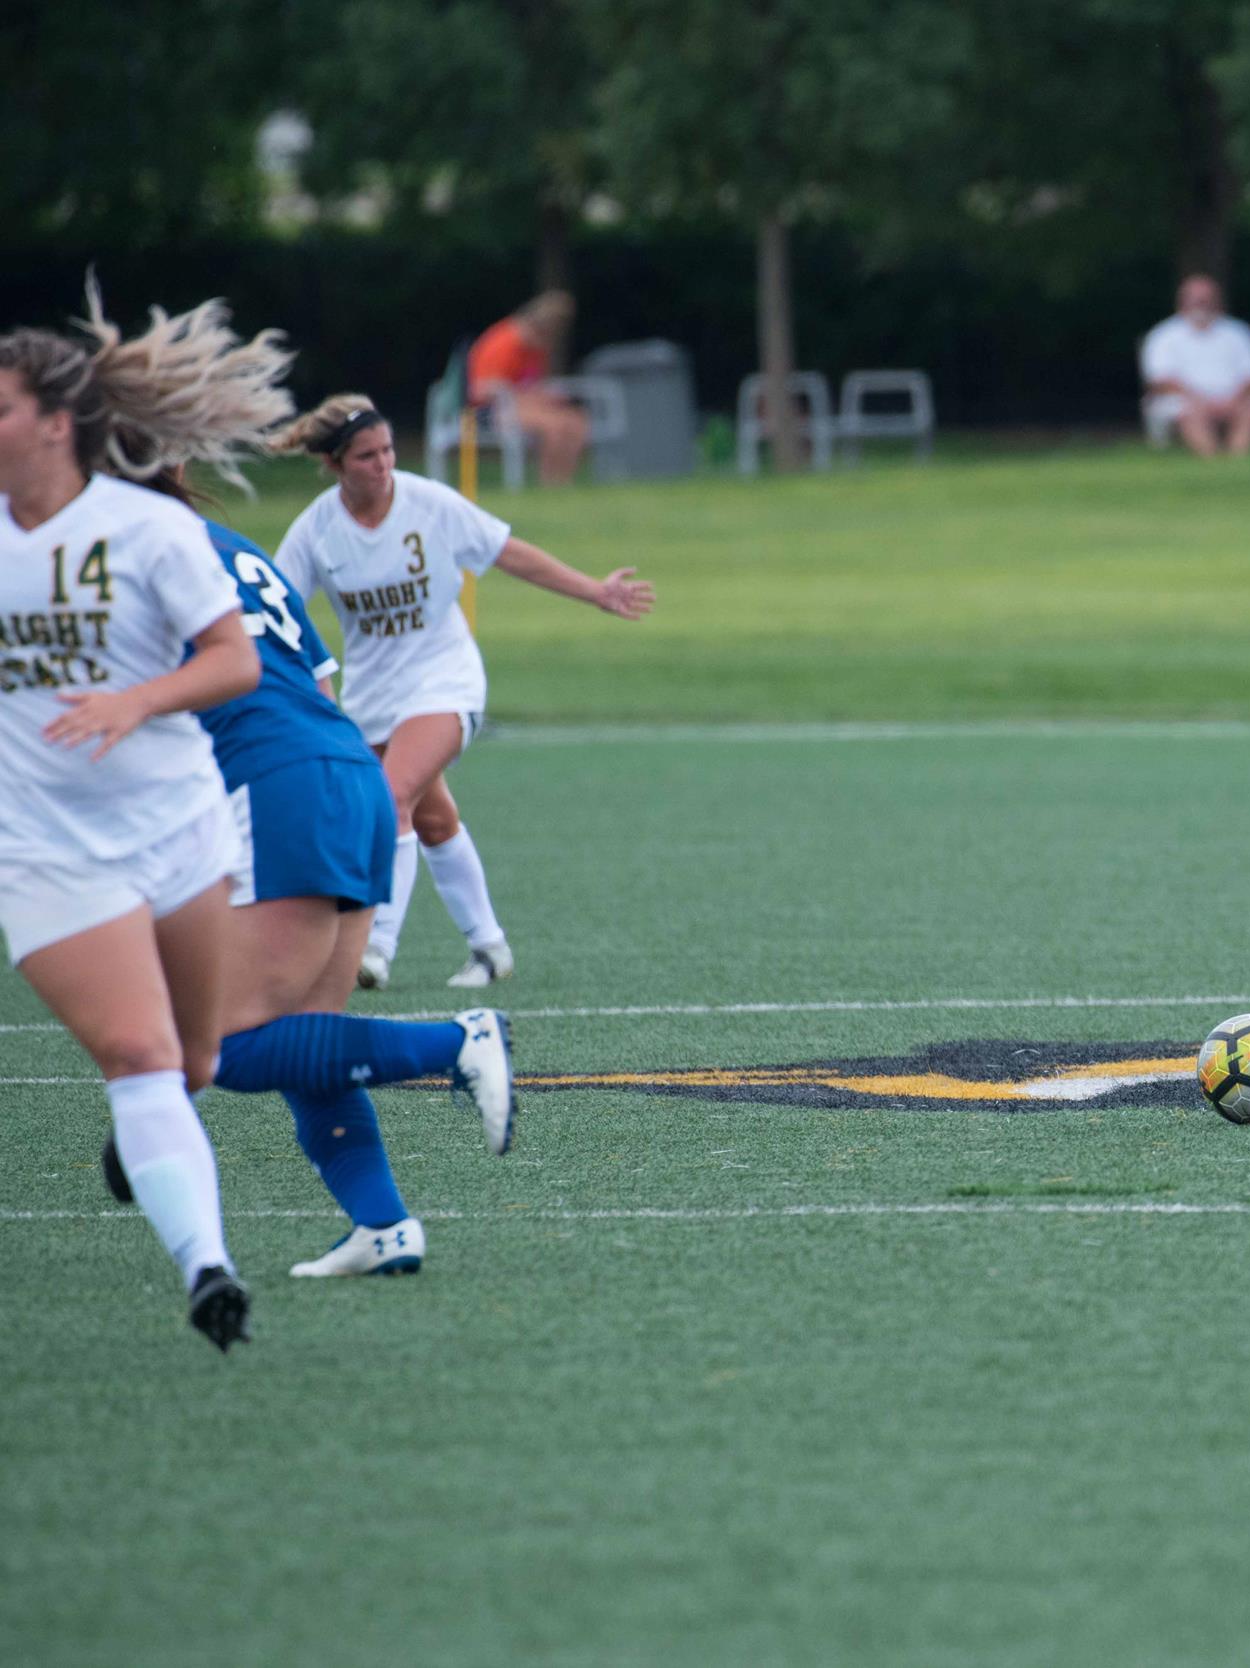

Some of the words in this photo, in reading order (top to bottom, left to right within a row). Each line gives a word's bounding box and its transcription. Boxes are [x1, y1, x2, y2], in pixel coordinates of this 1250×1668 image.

[51, 538, 112, 605] 14
[403, 531, 426, 575] 3
[337, 575, 431, 614] WRIGHT
[0, 611, 110, 649] IGHT
[359, 606, 425, 638] STATE
